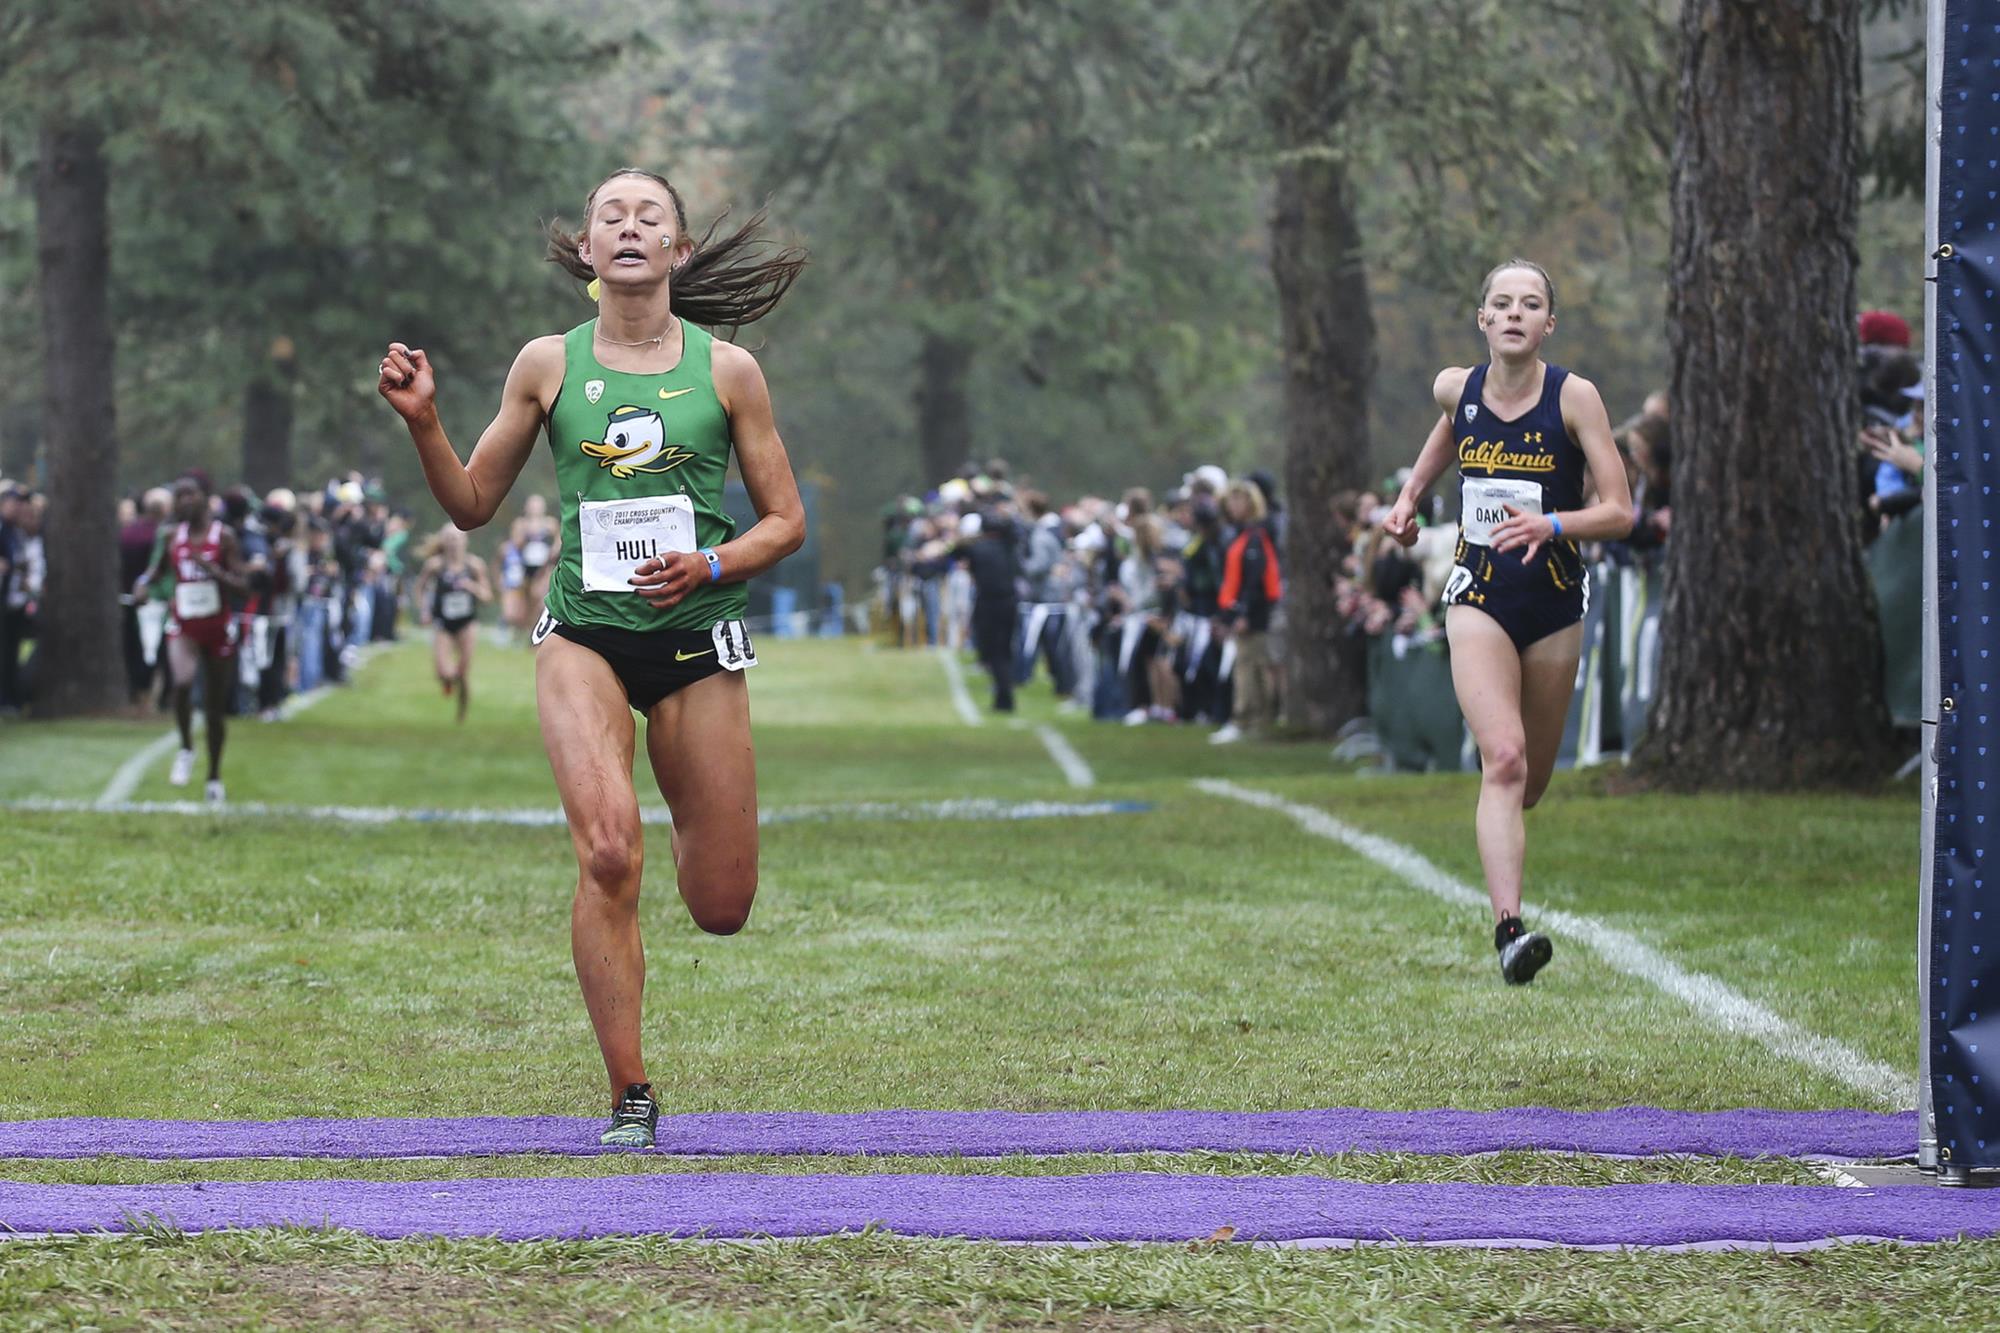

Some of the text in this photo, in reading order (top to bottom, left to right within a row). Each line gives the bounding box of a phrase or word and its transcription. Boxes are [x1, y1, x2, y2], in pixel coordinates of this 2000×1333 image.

[1459, 435, 1556, 475] California
[615, 506, 676, 519] 2017 CROSS COUNTRY
[613, 515, 660, 526] CHAMPIONSHIPS
